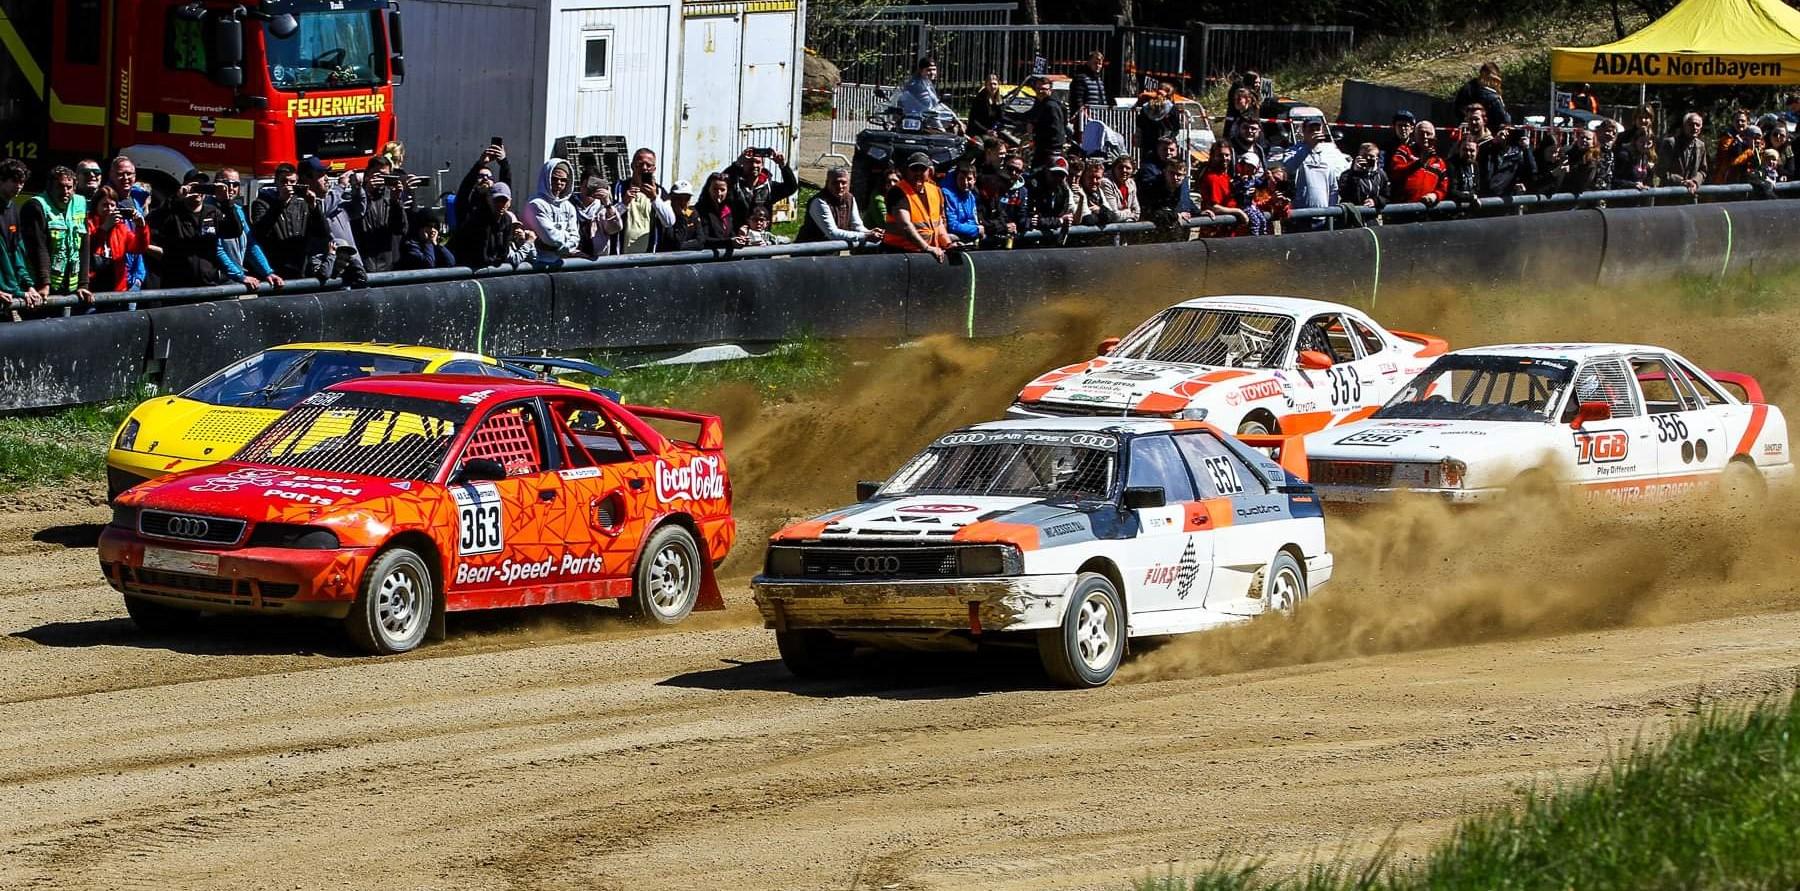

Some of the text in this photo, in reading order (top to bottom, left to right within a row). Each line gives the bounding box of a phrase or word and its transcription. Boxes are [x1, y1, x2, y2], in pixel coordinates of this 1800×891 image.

[1593, 53, 1782, 79] ADAC Nordbayern
[287, 93, 386, 118] FEUERWEHR
[5, 141, 38, 159] 112
[1241, 380, 1281, 400] TOYOTA
[1326, 365, 1361, 406] 353
[1648, 413, 1689, 443] 356
[1577, 434, 1627, 459] TGB
[292, 475, 356, 483] Bear
[1205, 456, 1243, 493] 352
[1597, 466, 1609, 475] Play
[262, 489, 333, 505] Parts
[275, 481, 362, 496] Speed
[1236, 504, 1281, 517] quattro
[462, 506, 500, 549] 363
[559, 553, 602, 576] Parts
